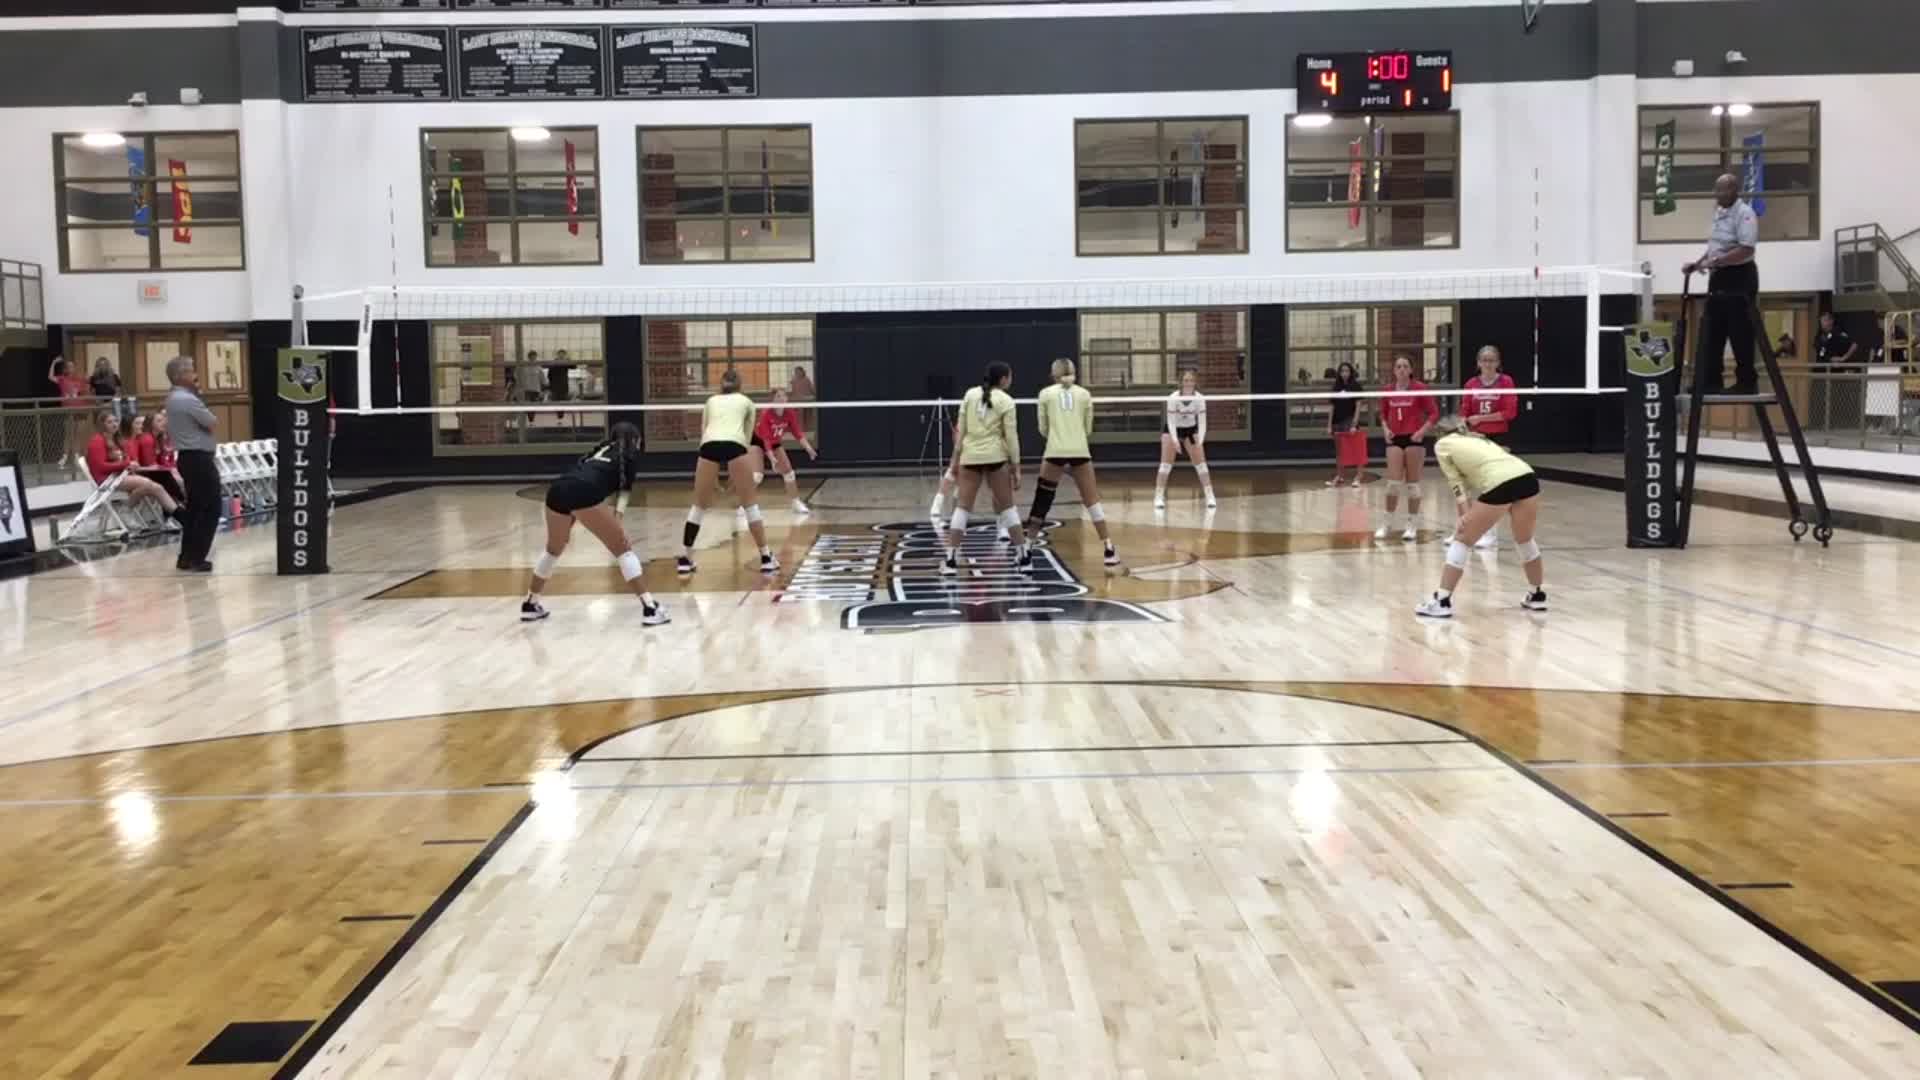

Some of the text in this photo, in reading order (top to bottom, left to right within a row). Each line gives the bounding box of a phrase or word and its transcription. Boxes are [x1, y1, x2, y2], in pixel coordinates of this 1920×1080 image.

[1307, 59, 1332, 69] Home
[1368, 55, 1408, 80] 1:00
[1416, 55, 1448, 66] Guests
[1321, 71, 1337, 95] 4
[1443, 69, 1449, 92] 1
[1361, 96, 1390, 106] period
[1405, 89, 1411, 106] 1
[1645, 383, 1661, 538] BULLDOGS
[293, 409, 310, 567] BULLDOGS
